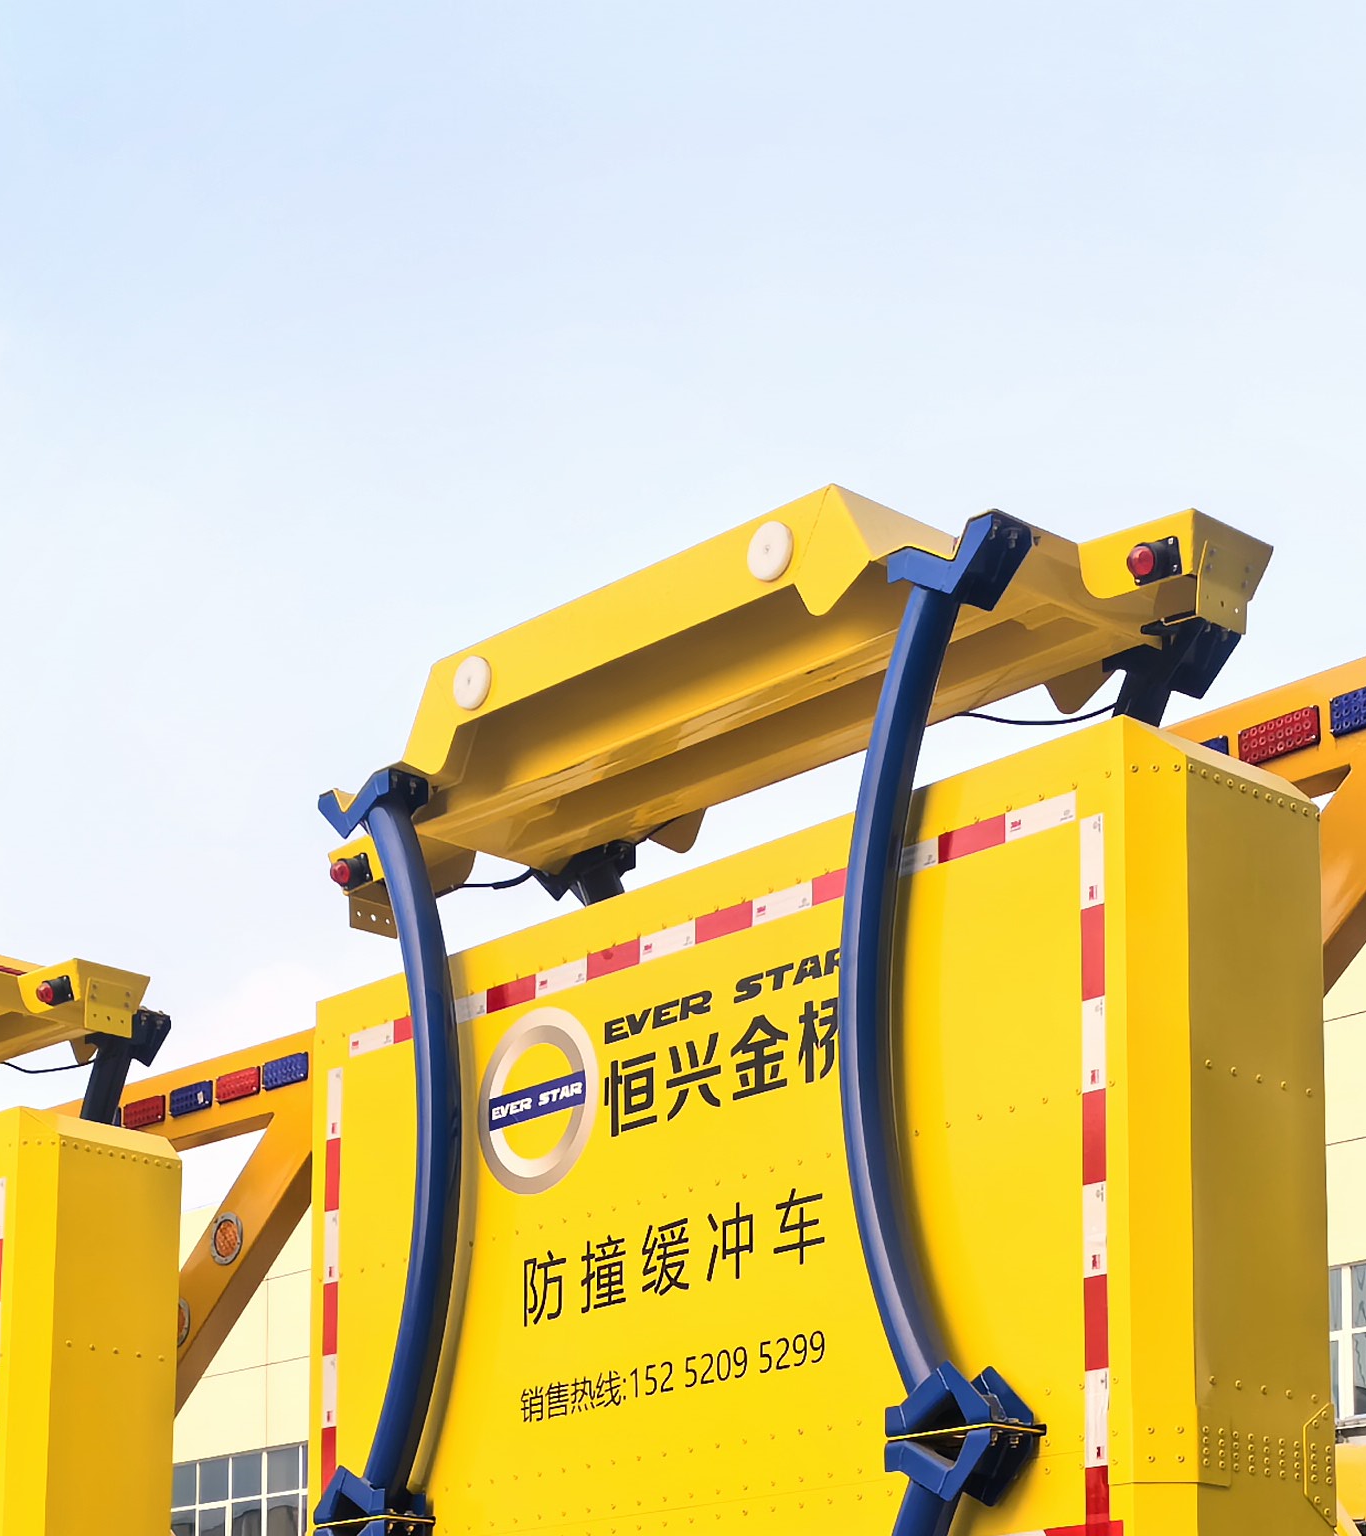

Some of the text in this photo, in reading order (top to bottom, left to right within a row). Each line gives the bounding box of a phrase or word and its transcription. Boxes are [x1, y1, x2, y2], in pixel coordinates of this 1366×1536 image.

[604, 990, 711, 1045] EVER
[491, 1082, 583, 1120] EVER STAR
[522, 1188, 826, 1327] 防撞缓冲车
[685, 1346, 747, 1388] 5209
[759, 1330, 826, 1373] 5299
